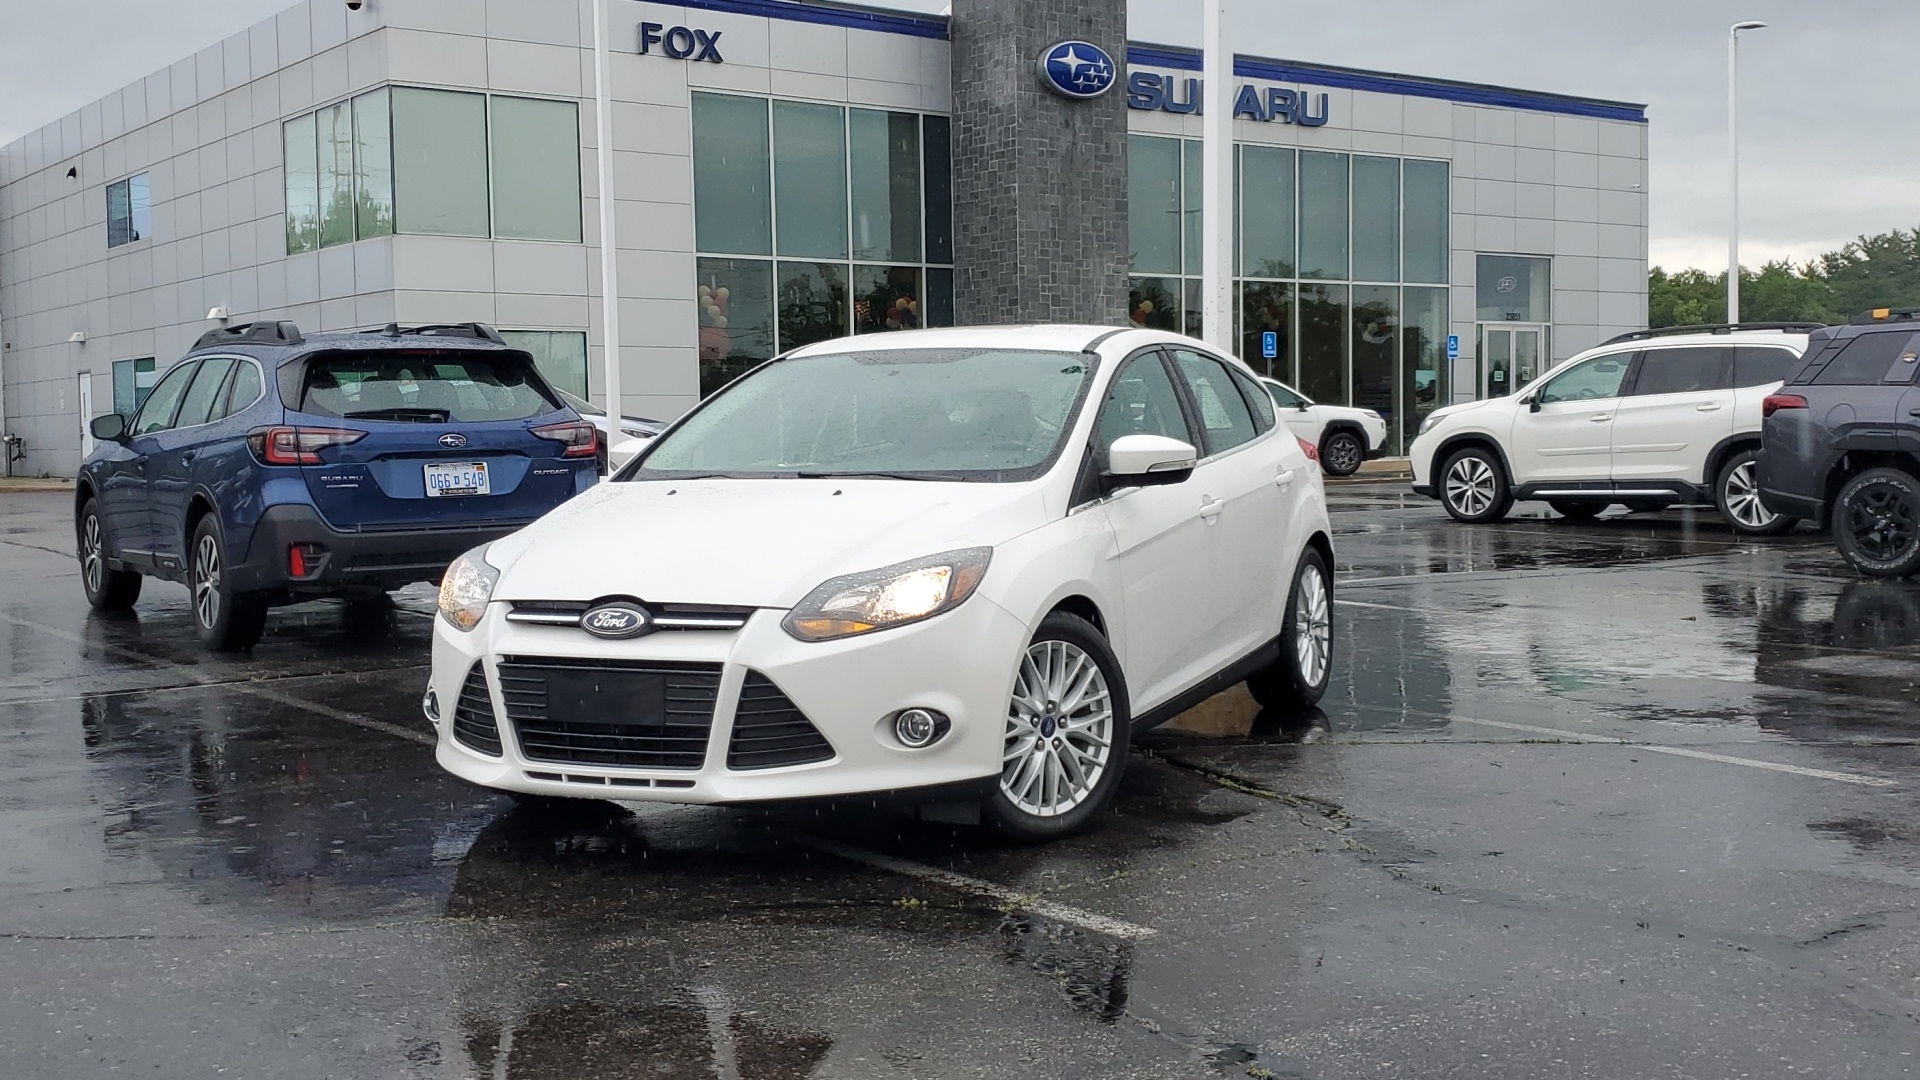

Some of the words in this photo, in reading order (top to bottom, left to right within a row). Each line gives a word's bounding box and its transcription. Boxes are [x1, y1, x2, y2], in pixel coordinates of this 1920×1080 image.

[638, 21, 724, 63] FOX
[1128, 71, 1329, 127] SUARU
[430, 473, 451, 489] 066
[463, 471, 485, 487] 548
[593, 611, 630, 628] Ford
